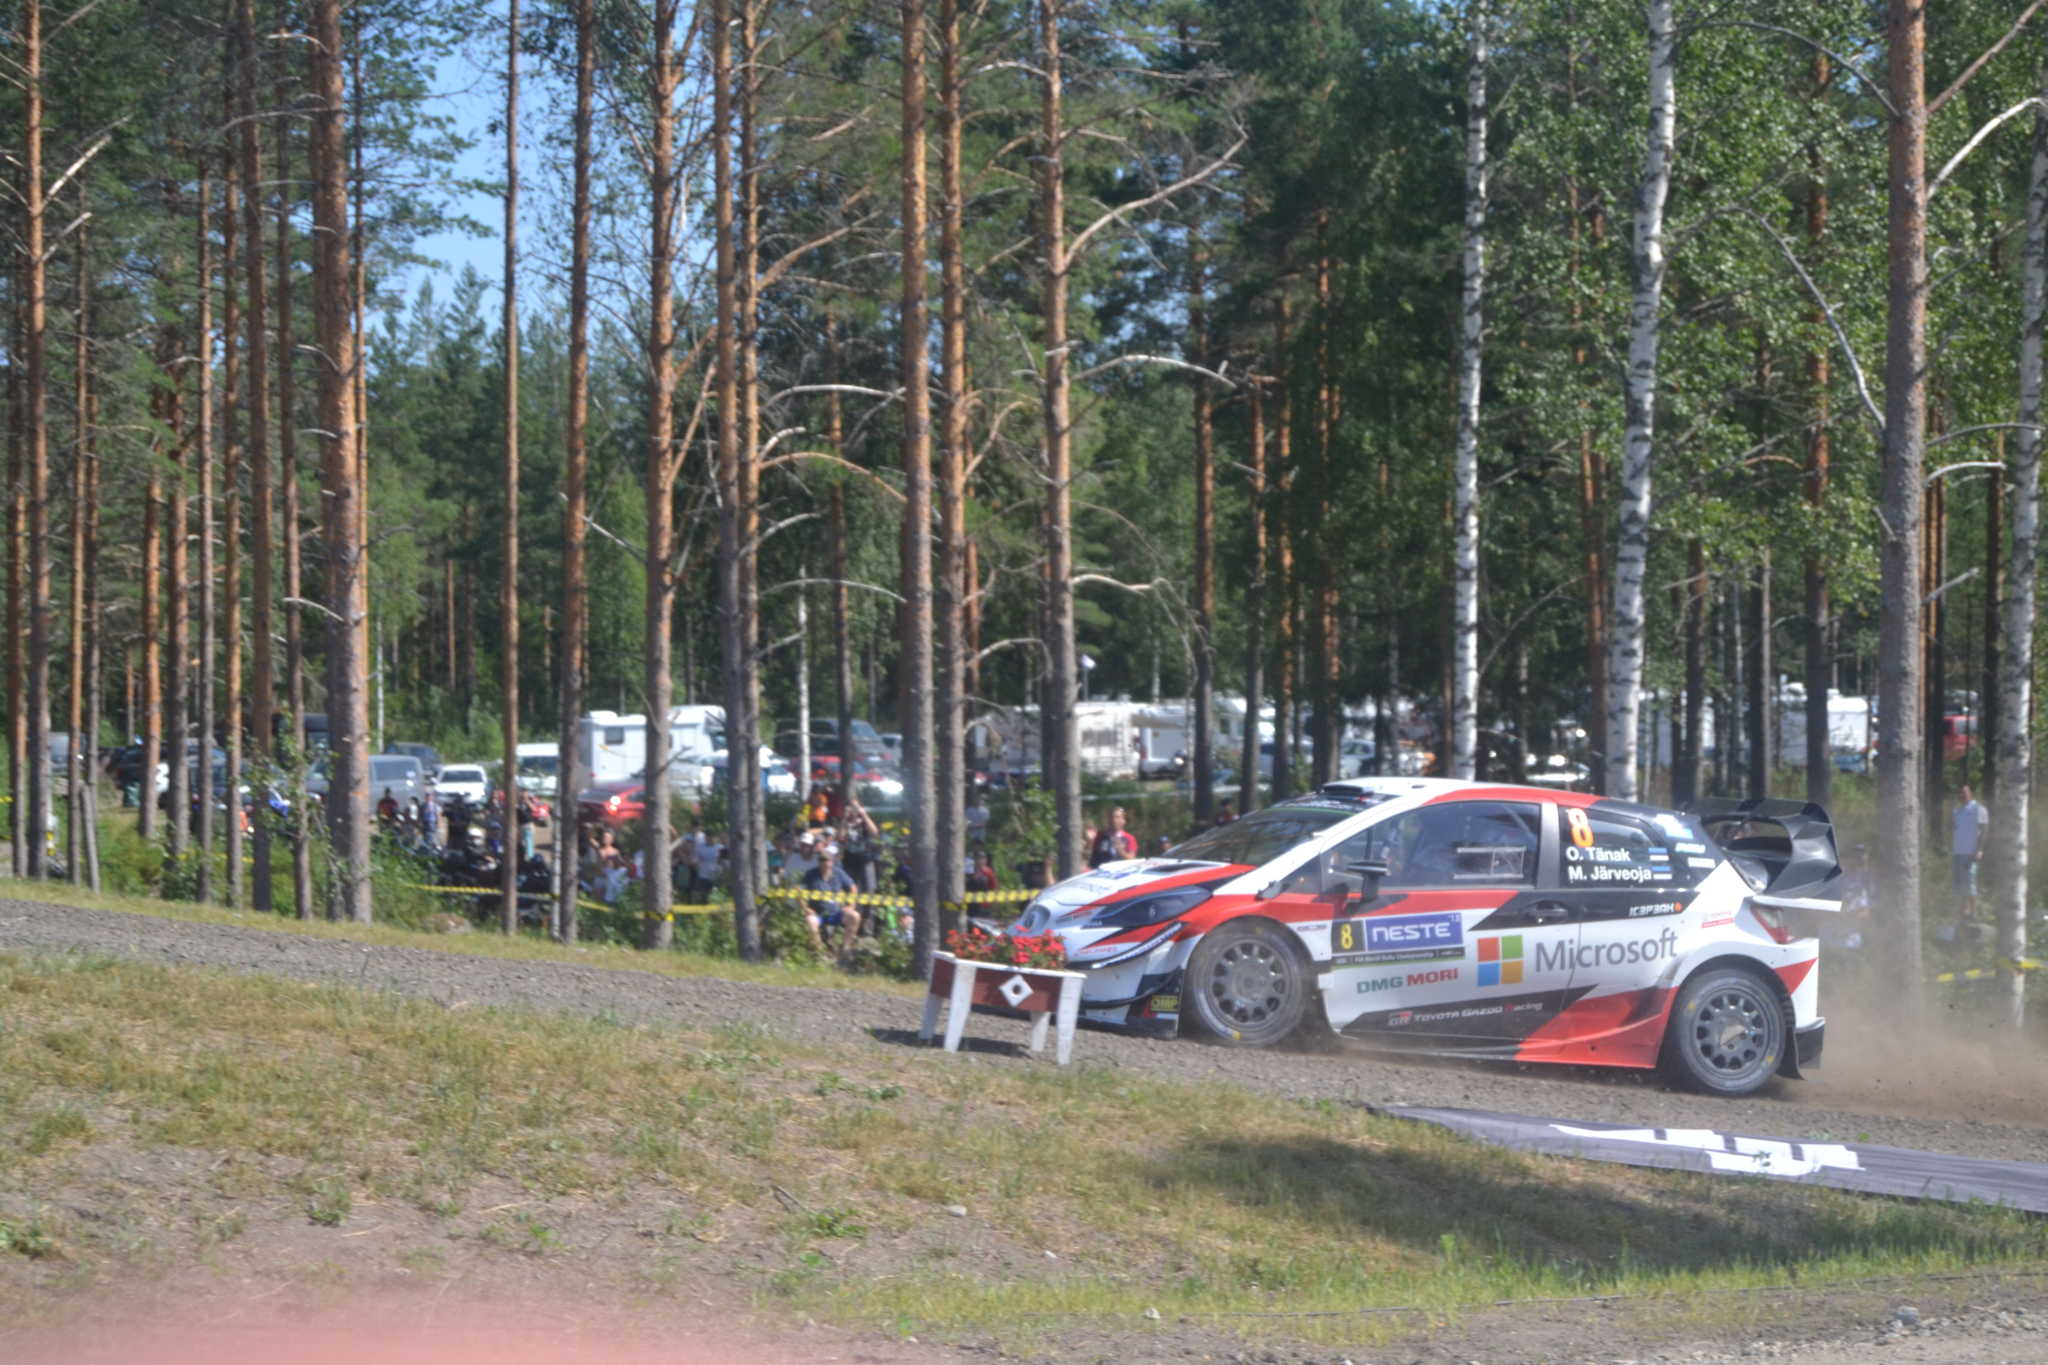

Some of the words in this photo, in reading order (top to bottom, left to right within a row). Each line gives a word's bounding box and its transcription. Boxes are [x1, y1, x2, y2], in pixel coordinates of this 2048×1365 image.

[1567, 807, 1594, 848] 8
[1566, 846, 1584, 861] O.
[1585, 847, 1631, 862] Tänak
[1568, 865, 1588, 881] M.
[1591, 865, 1653, 883] Järveoja
[1341, 923, 1353, 950] 8
[1372, 921, 1452, 943] NESTE
[1535, 927, 1678, 973] Microsoft
[1357, 976, 1403, 994] DMG
[1407, 967, 1459, 987] MORI
[1414, 1010, 1460, 1022] TOYOTA
